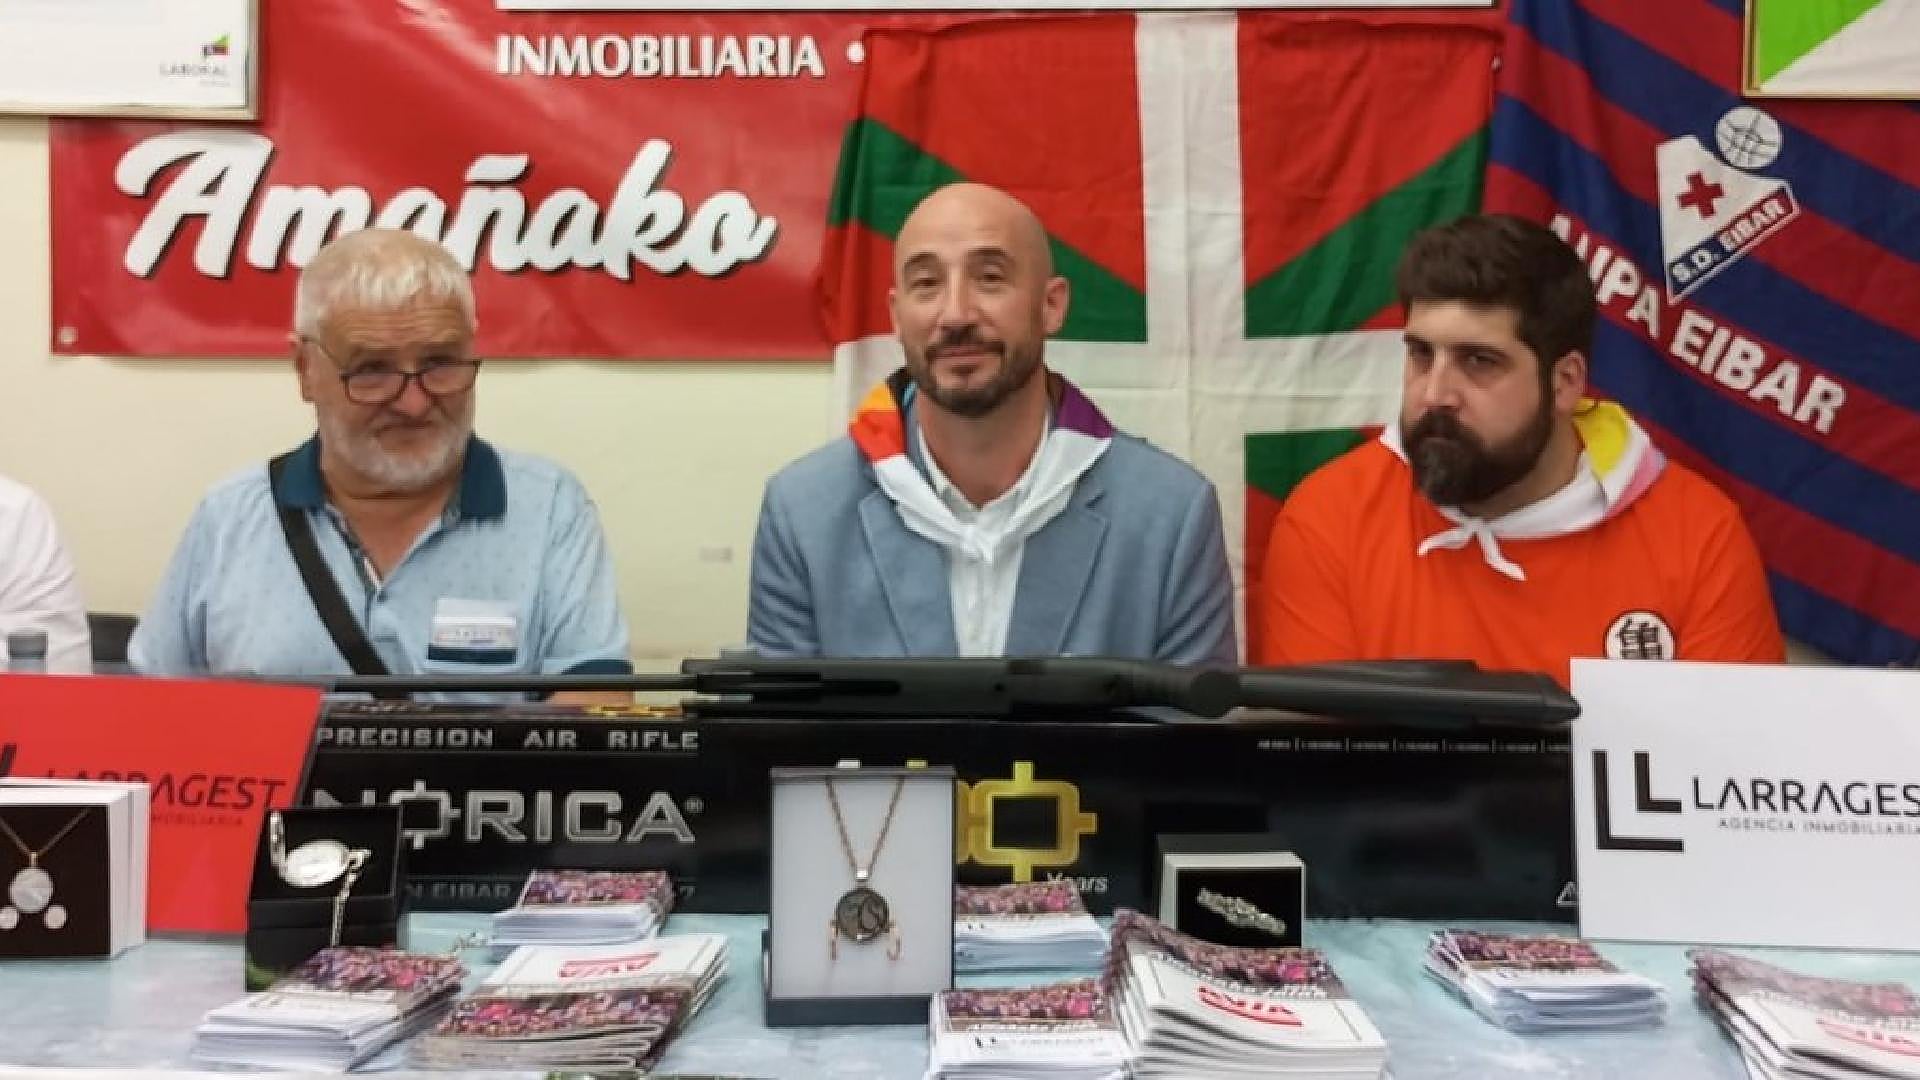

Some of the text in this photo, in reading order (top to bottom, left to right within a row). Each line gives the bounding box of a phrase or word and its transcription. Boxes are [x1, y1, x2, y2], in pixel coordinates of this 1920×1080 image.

[495, 34, 826, 77] INMOBILIARIA
[114, 130, 778, 280] Amañako
[1672, 198, 1786, 283] S.D. EIBAR
[1671, 309, 1846, 434] EIBAR
[317, 727, 699, 749] PRECISION AIR RIFLE
[1718, 817, 1795, 832] AGENCIA
